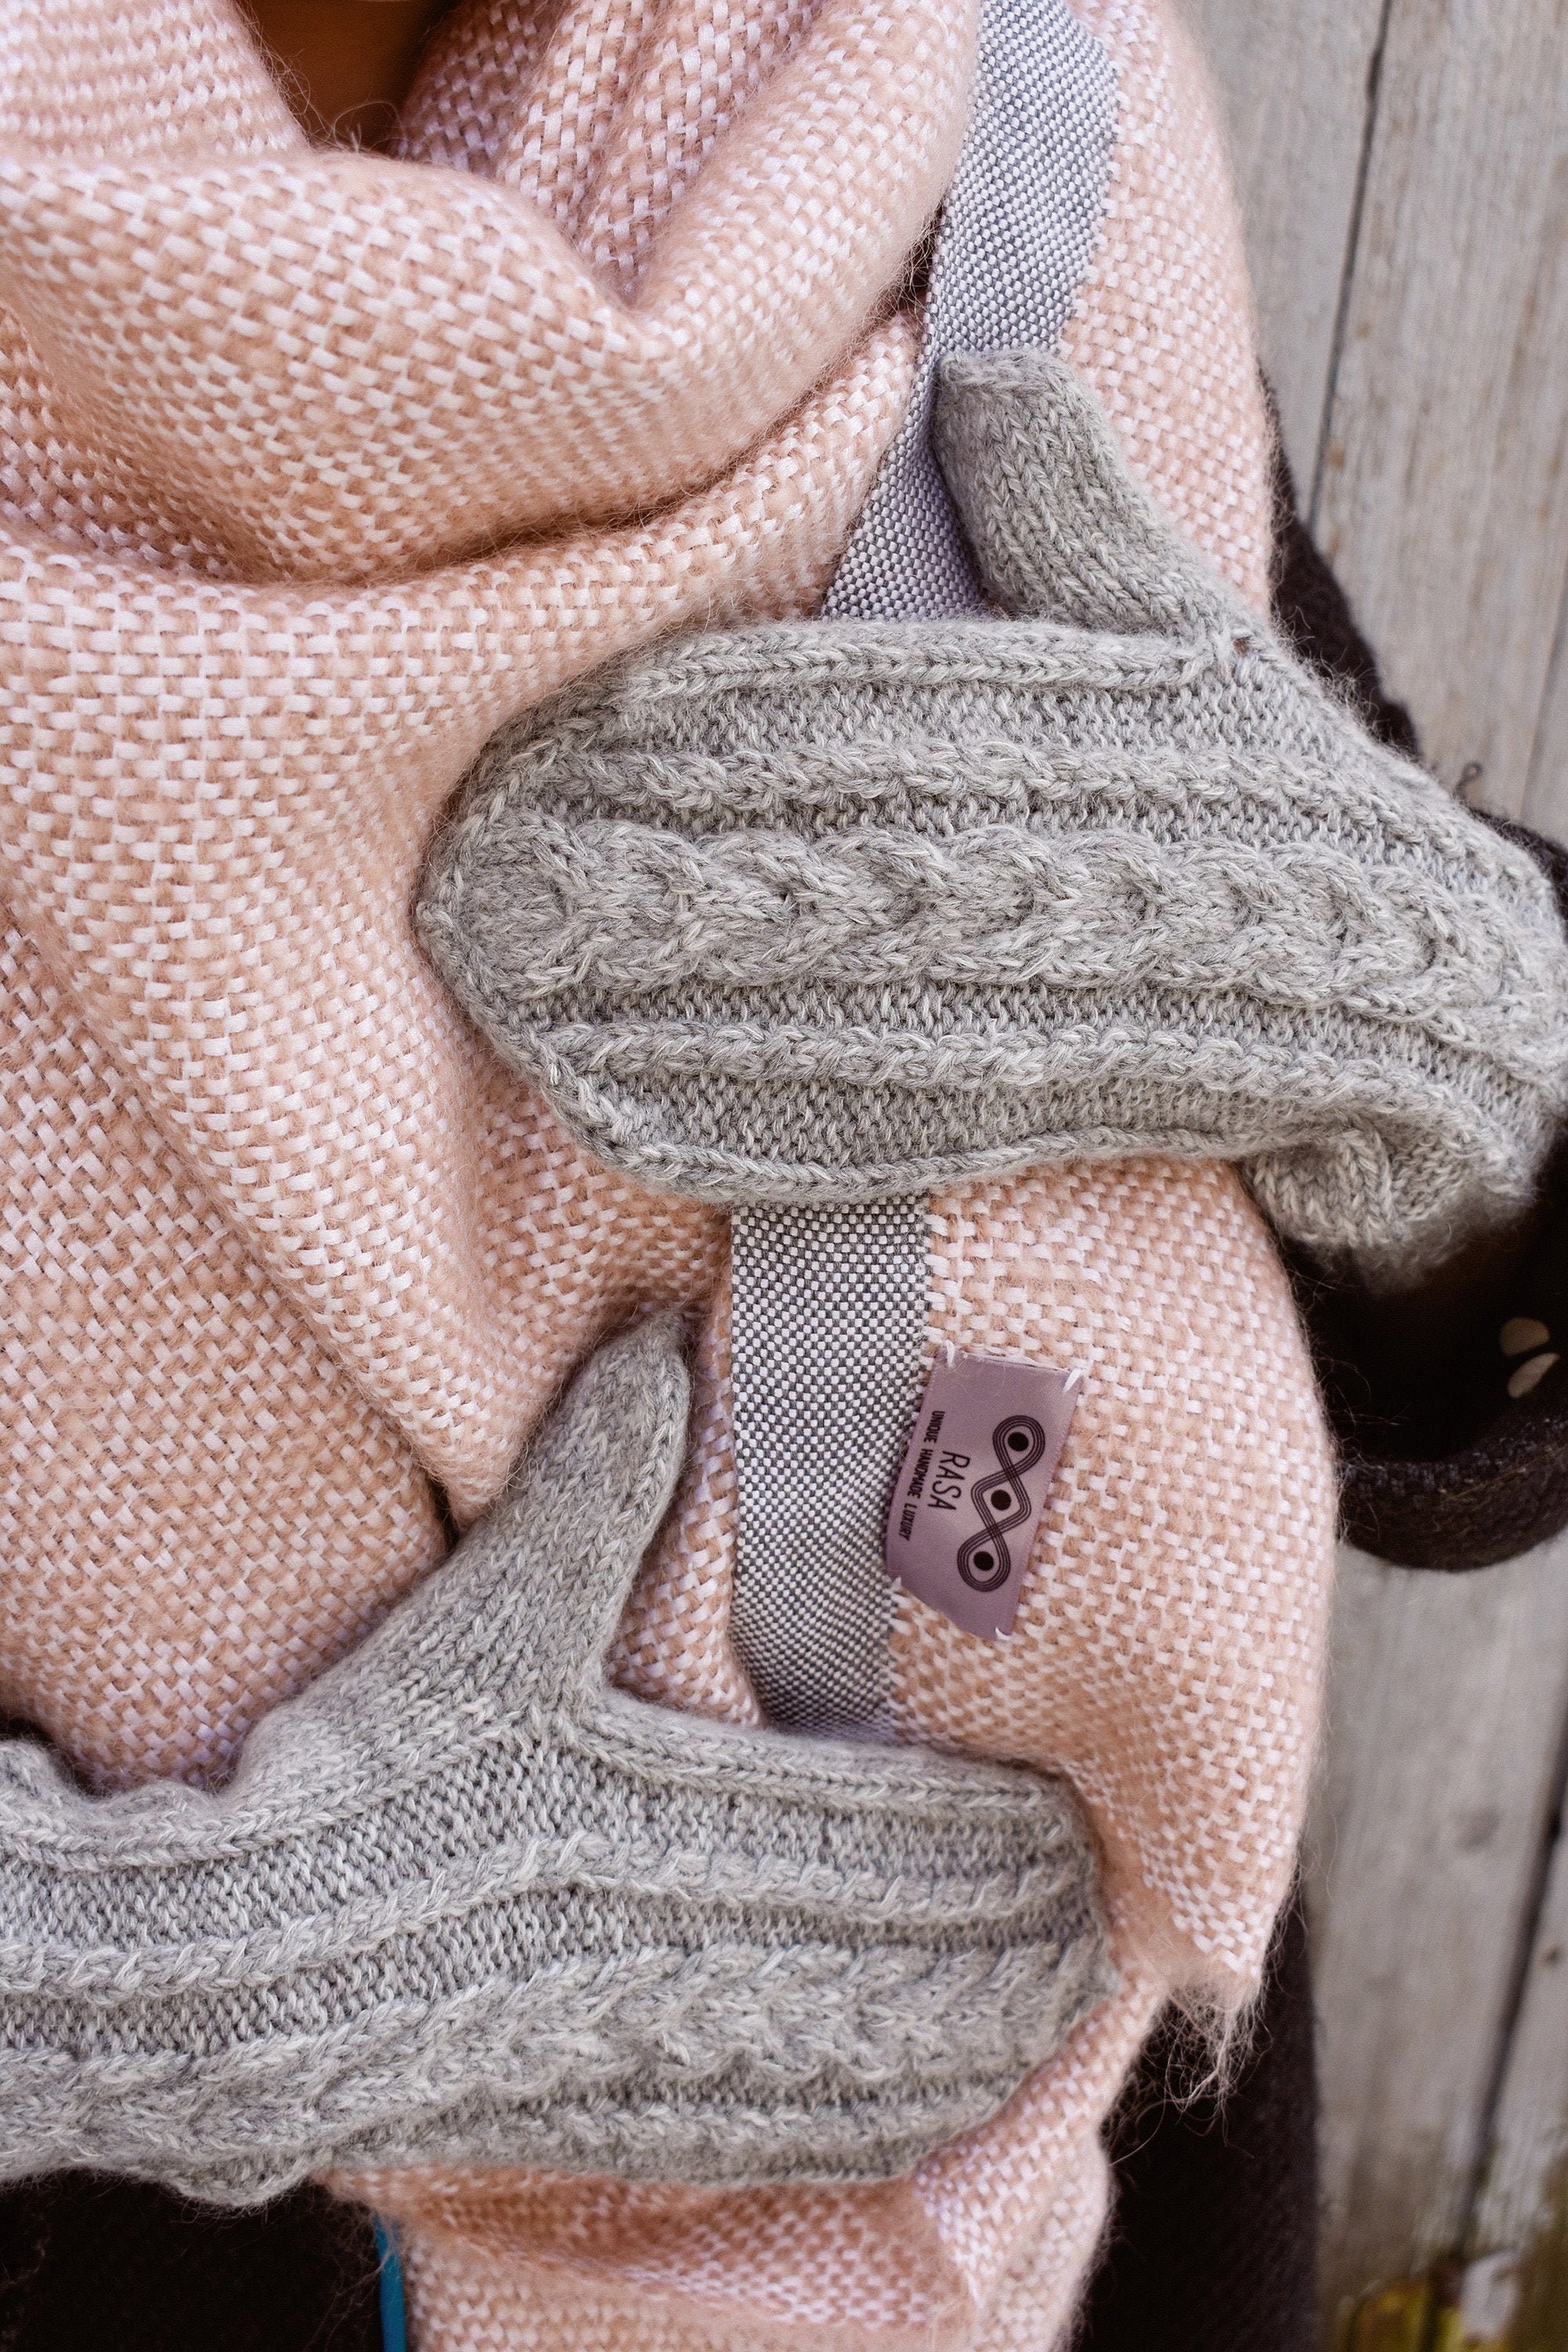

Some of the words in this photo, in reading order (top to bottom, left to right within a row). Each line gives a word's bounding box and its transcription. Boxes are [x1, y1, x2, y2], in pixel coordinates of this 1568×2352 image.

[924, 1410, 946, 1444] UNIQUE
[907, 1448, 934, 1499] HANDMADE
[927, 1450, 971, 1511] RASA
[898, 1502, 917, 1541] LUXURY
